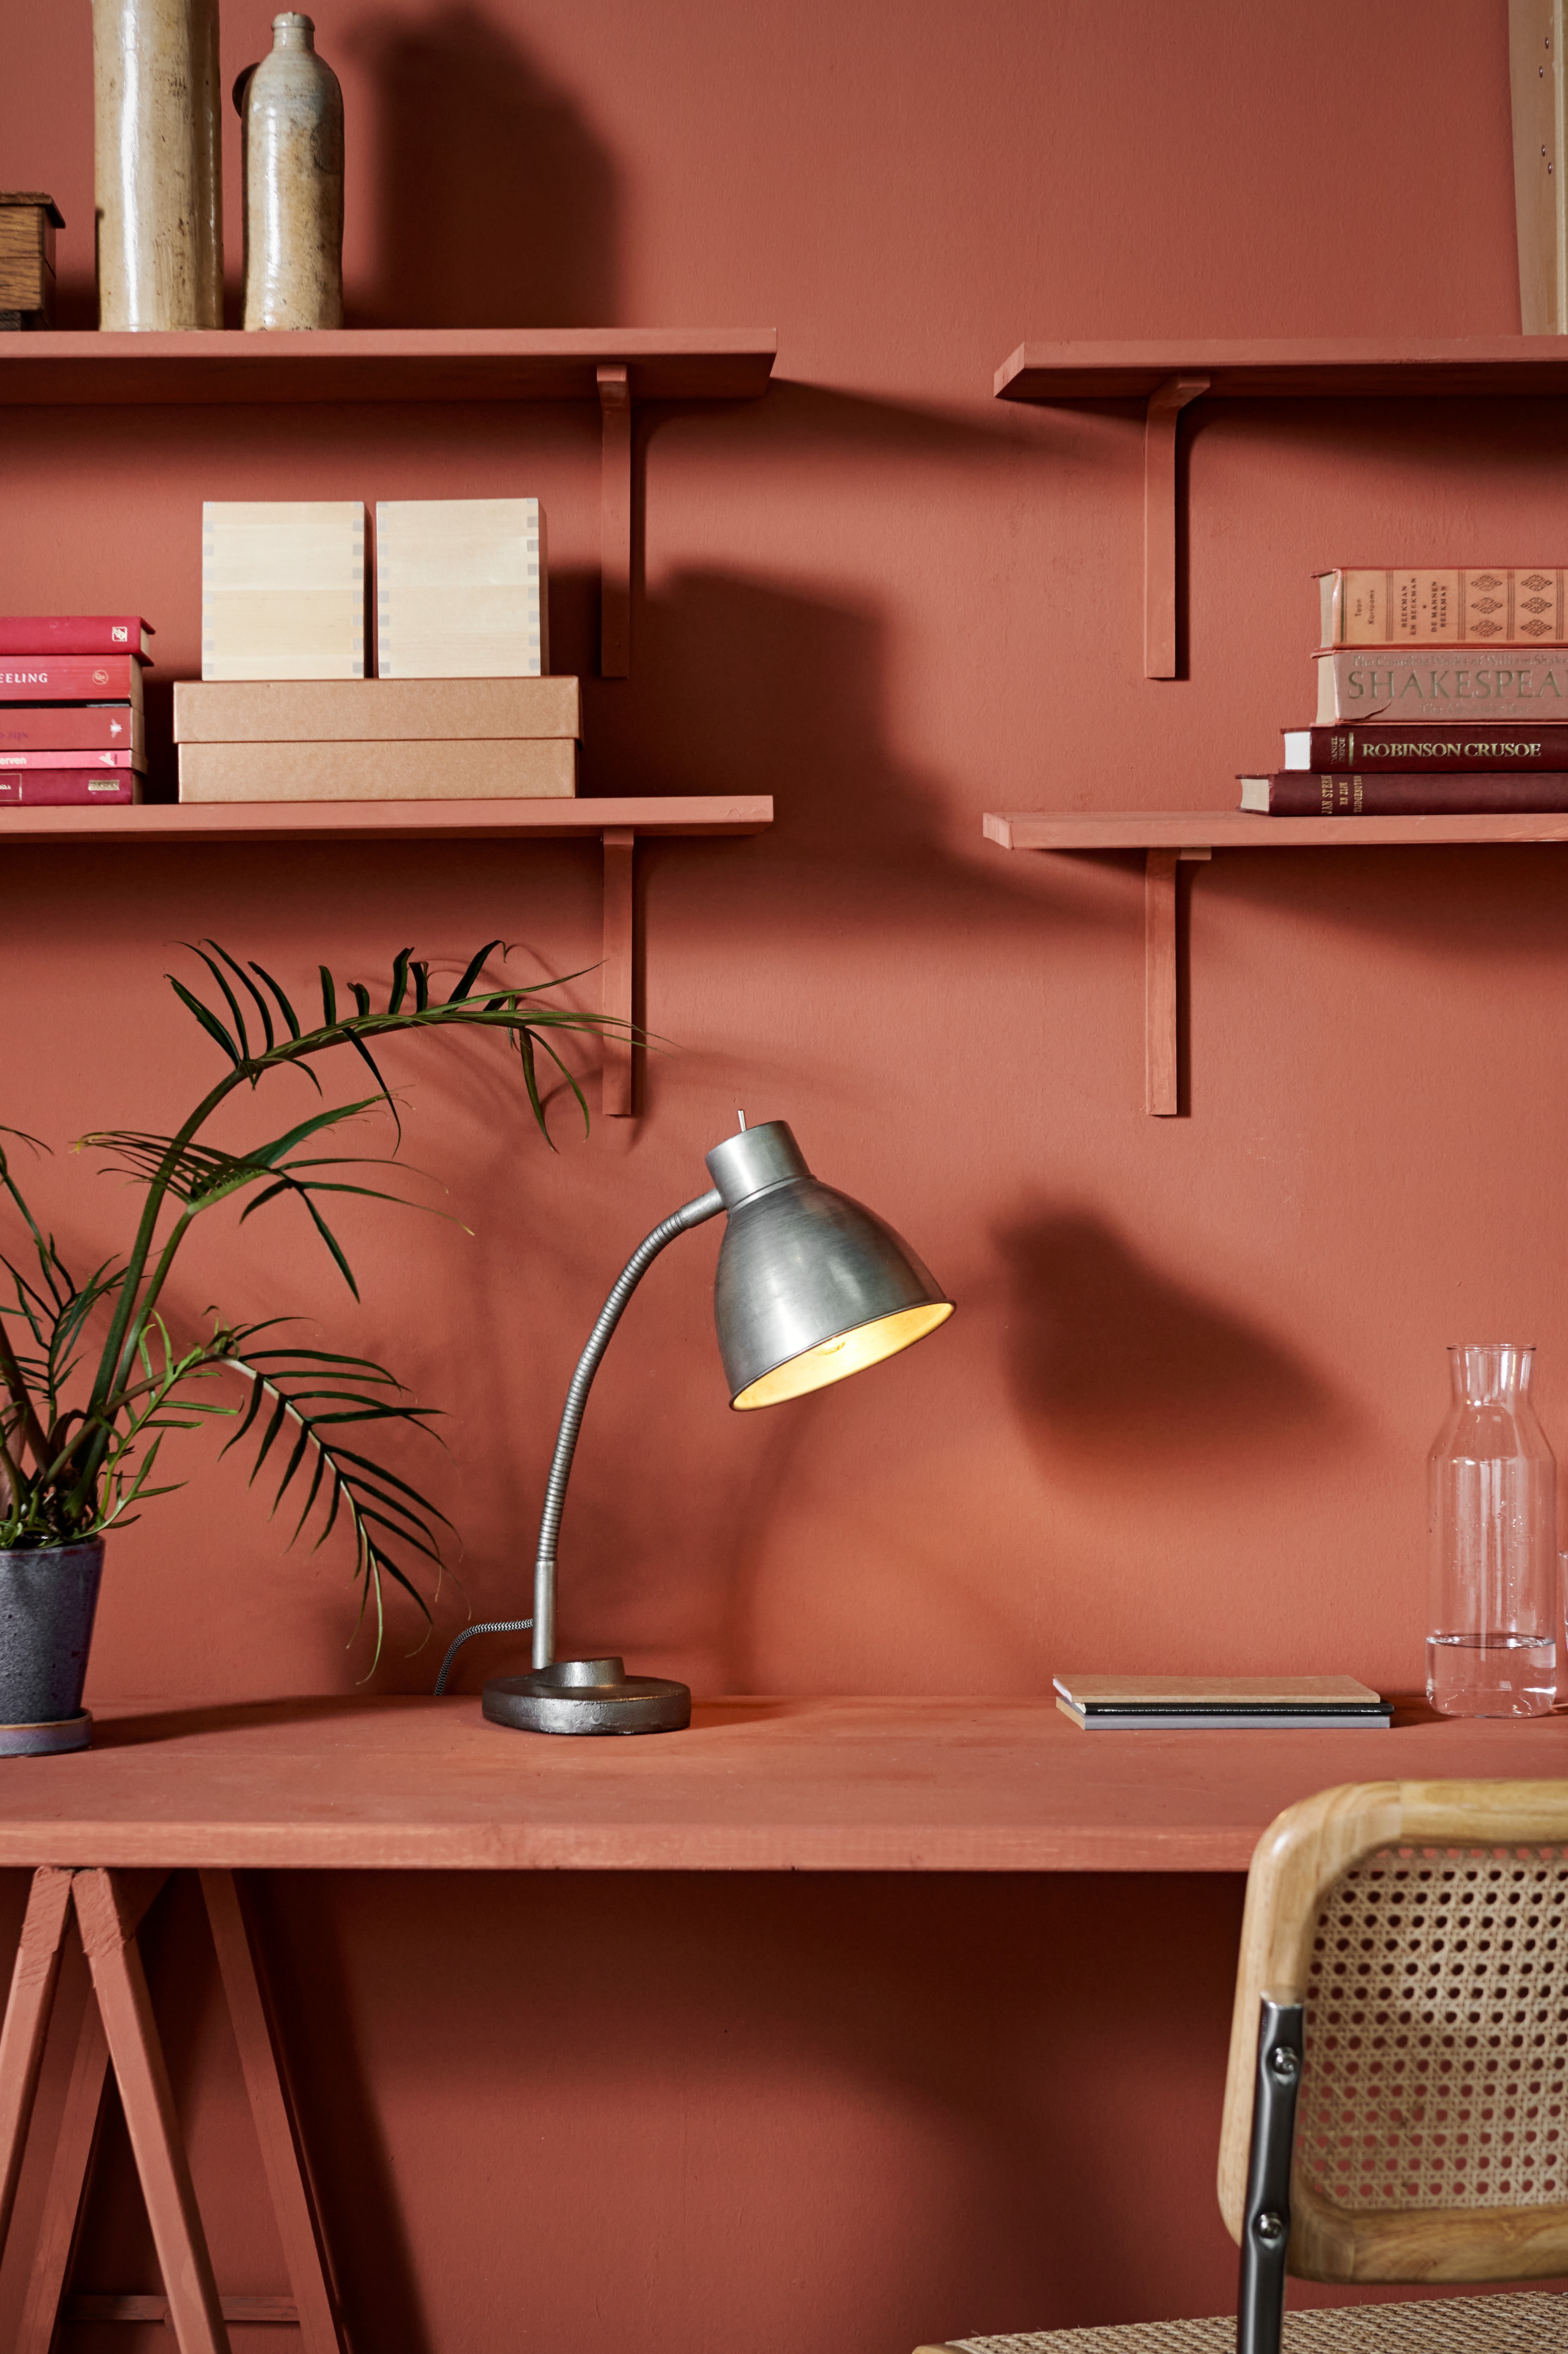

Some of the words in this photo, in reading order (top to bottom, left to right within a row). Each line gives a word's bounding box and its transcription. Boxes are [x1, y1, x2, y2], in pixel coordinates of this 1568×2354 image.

[1411, 625, 1416, 635] EN
[1431, 621, 1437, 632] DE
[1351, 655, 1374, 667] The
[1431, 655, 1469, 666] Works
[1470, 655, 1484, 666] of
[1348, 669, 1568, 699] SHAKESPEA
[1361, 743, 1462, 757] ROBINSON
[1464, 743, 1541, 757] CRUSOE
[1321, 775, 1333, 798] STEEN
[1339, 782, 1348, 795] ZIJN
[1353, 776, 1363, 813] TIJDGENOTEN
[1321, 801, 1333, 814] JAN
